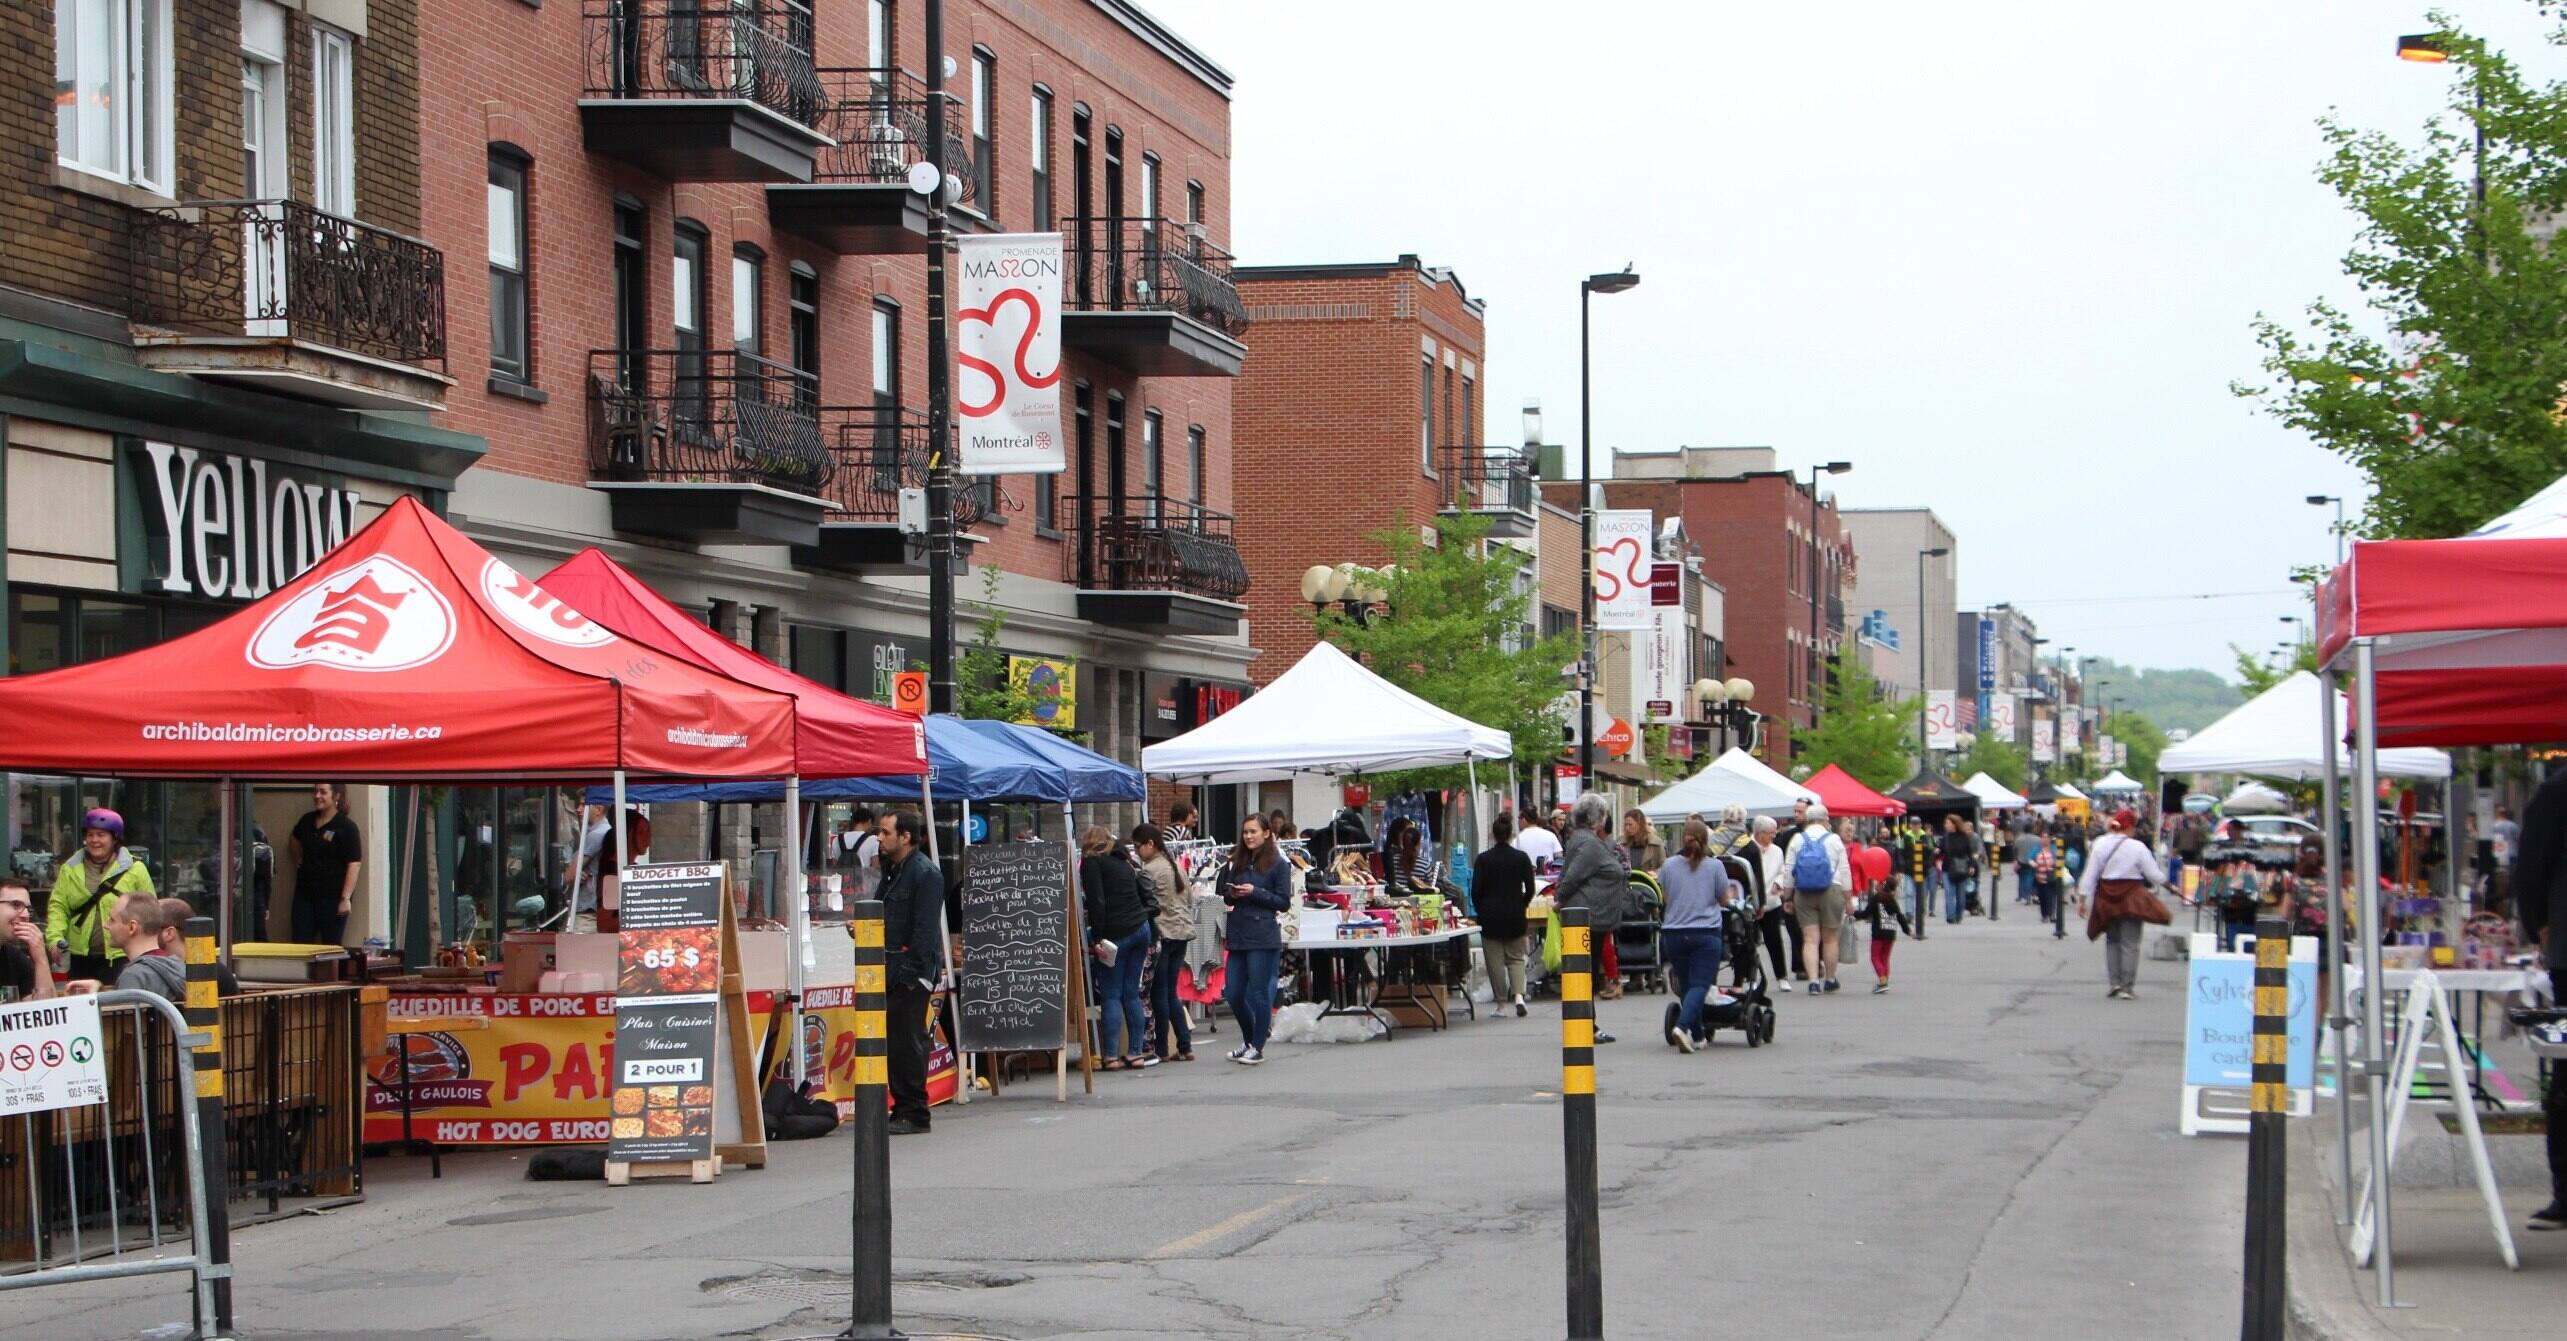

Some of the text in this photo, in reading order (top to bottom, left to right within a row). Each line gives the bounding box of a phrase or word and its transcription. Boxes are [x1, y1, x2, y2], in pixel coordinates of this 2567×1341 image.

[1001, 247, 1057, 257] PROMENADE
[964, 258, 1057, 279] MASSON
[972, 435, 1033, 449] Montréal
[146, 441, 360, 600] Yellow
[142, 721, 442, 743] archibaldmicrobrasserie.ca
[631, 866, 711, 880] BUDGET BBQ
[1020, 862, 1032, 872] de
[972, 876, 1005, 890] mignon
[1010, 872, 1018, 887] 4
[1023, 873, 1045, 883] pour
[1017, 916, 1031, 927] de
[1010, 929, 1032, 940] pour
[643, 947, 700, 969] 65 $
[985, 958, 1000, 970] 3
[1004, 958, 1031, 971] pour
[987, 984, 1001, 999] 15
[1009, 983, 1034, 999] pour
[493, 998, 521, 1016] DE
[530, 997, 587, 1016] PORC
[0, 1006, 68, 1032] NTERDIT
[640, 1038, 688, 1051] Maison
[631, 1062, 696, 1076] 2 POUR 1
[87, 1084, 103, 1096] FRAIS
[420, 1086, 483, 1101] GAULOIS
[26, 1091, 45, 1104] FRAIS
[437, 1121, 481, 1141] HOT
[491, 1121, 541, 1141] DOG
